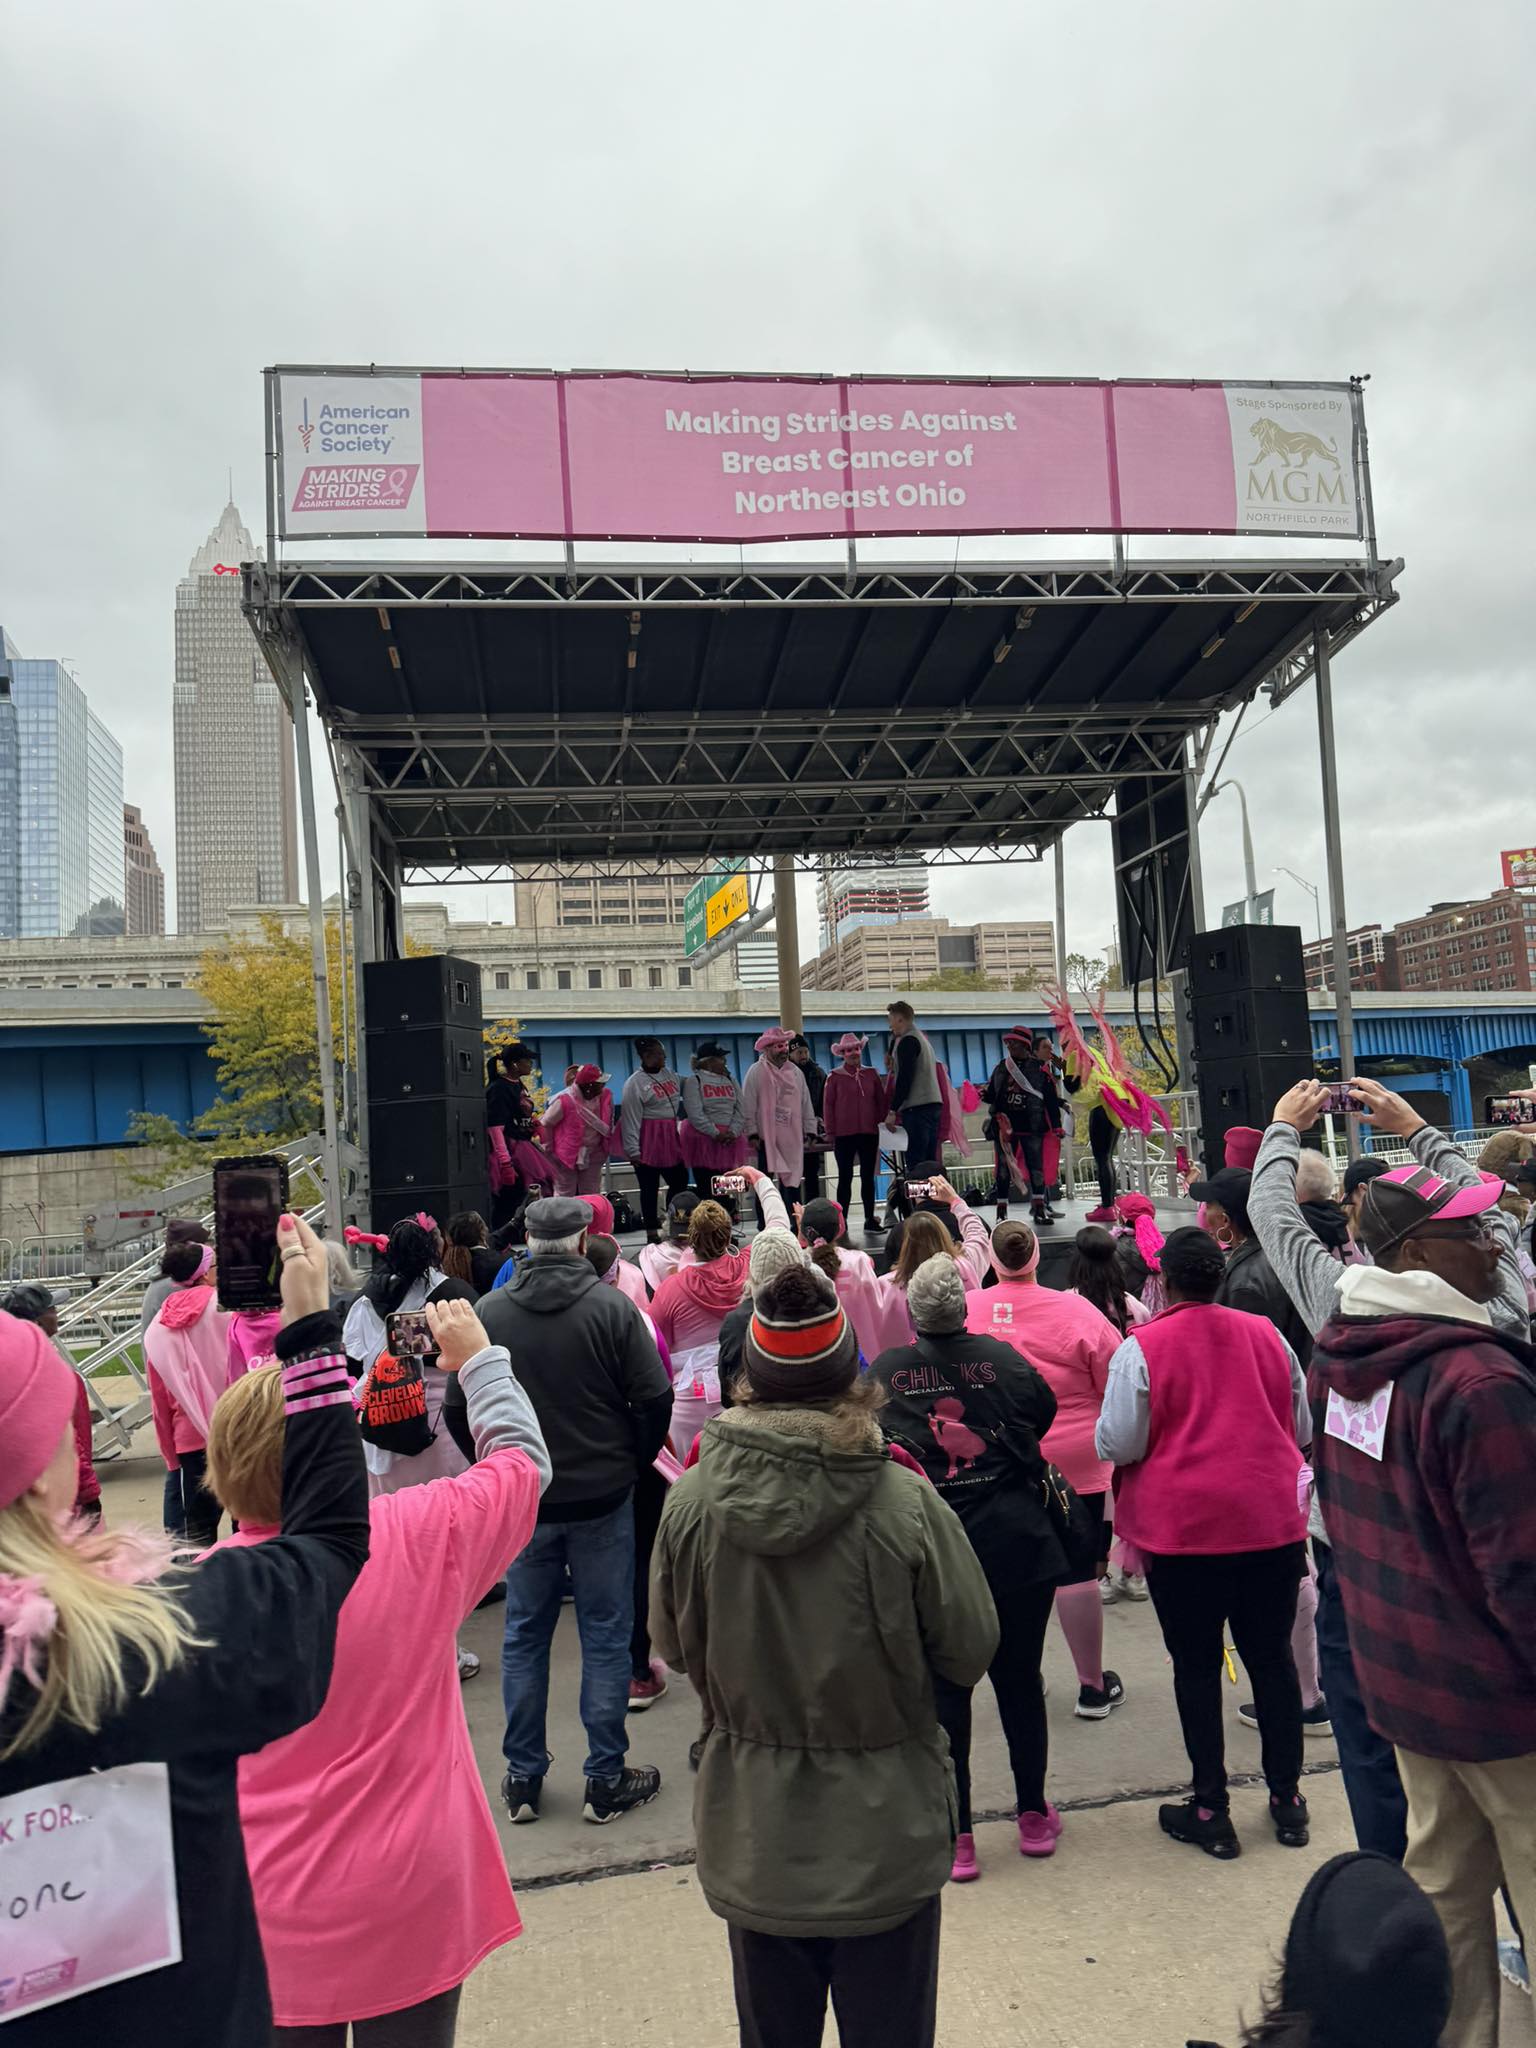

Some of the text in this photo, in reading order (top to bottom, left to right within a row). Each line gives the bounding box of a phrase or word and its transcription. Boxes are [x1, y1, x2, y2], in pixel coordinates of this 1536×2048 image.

[320, 404, 409, 419] American
[1236, 398, 1343, 413] Stage Sponsored By
[319, 421, 389, 435] Cancer
[665, 408, 1017, 442] Making Strides Against
[321, 436, 392, 455] Society
[722, 443, 974, 475] Breast Cancer of
[308, 469, 387, 484] MAKING
[303, 484, 381, 499] STRIDES
[1246, 468, 1349, 505] MGM
[298, 500, 334, 508] AGAINST
[335, 499, 365, 507] BREAST
[735, 480, 966, 514] Northeast Ohio
[1246, 513, 1349, 525] NORTHFIELD PARK
[711, 905, 721, 925] EXIT
[703, 1083, 734, 1098] CWC
[891, 1362, 997, 1391] CHIKS
[368, 1379, 425, 1406] CLEVELAN
[904, 1387, 937, 1396] SOCIAL
[368, 1396, 426, 1427] BROWN
[0, 1881, 87, 1919] one
